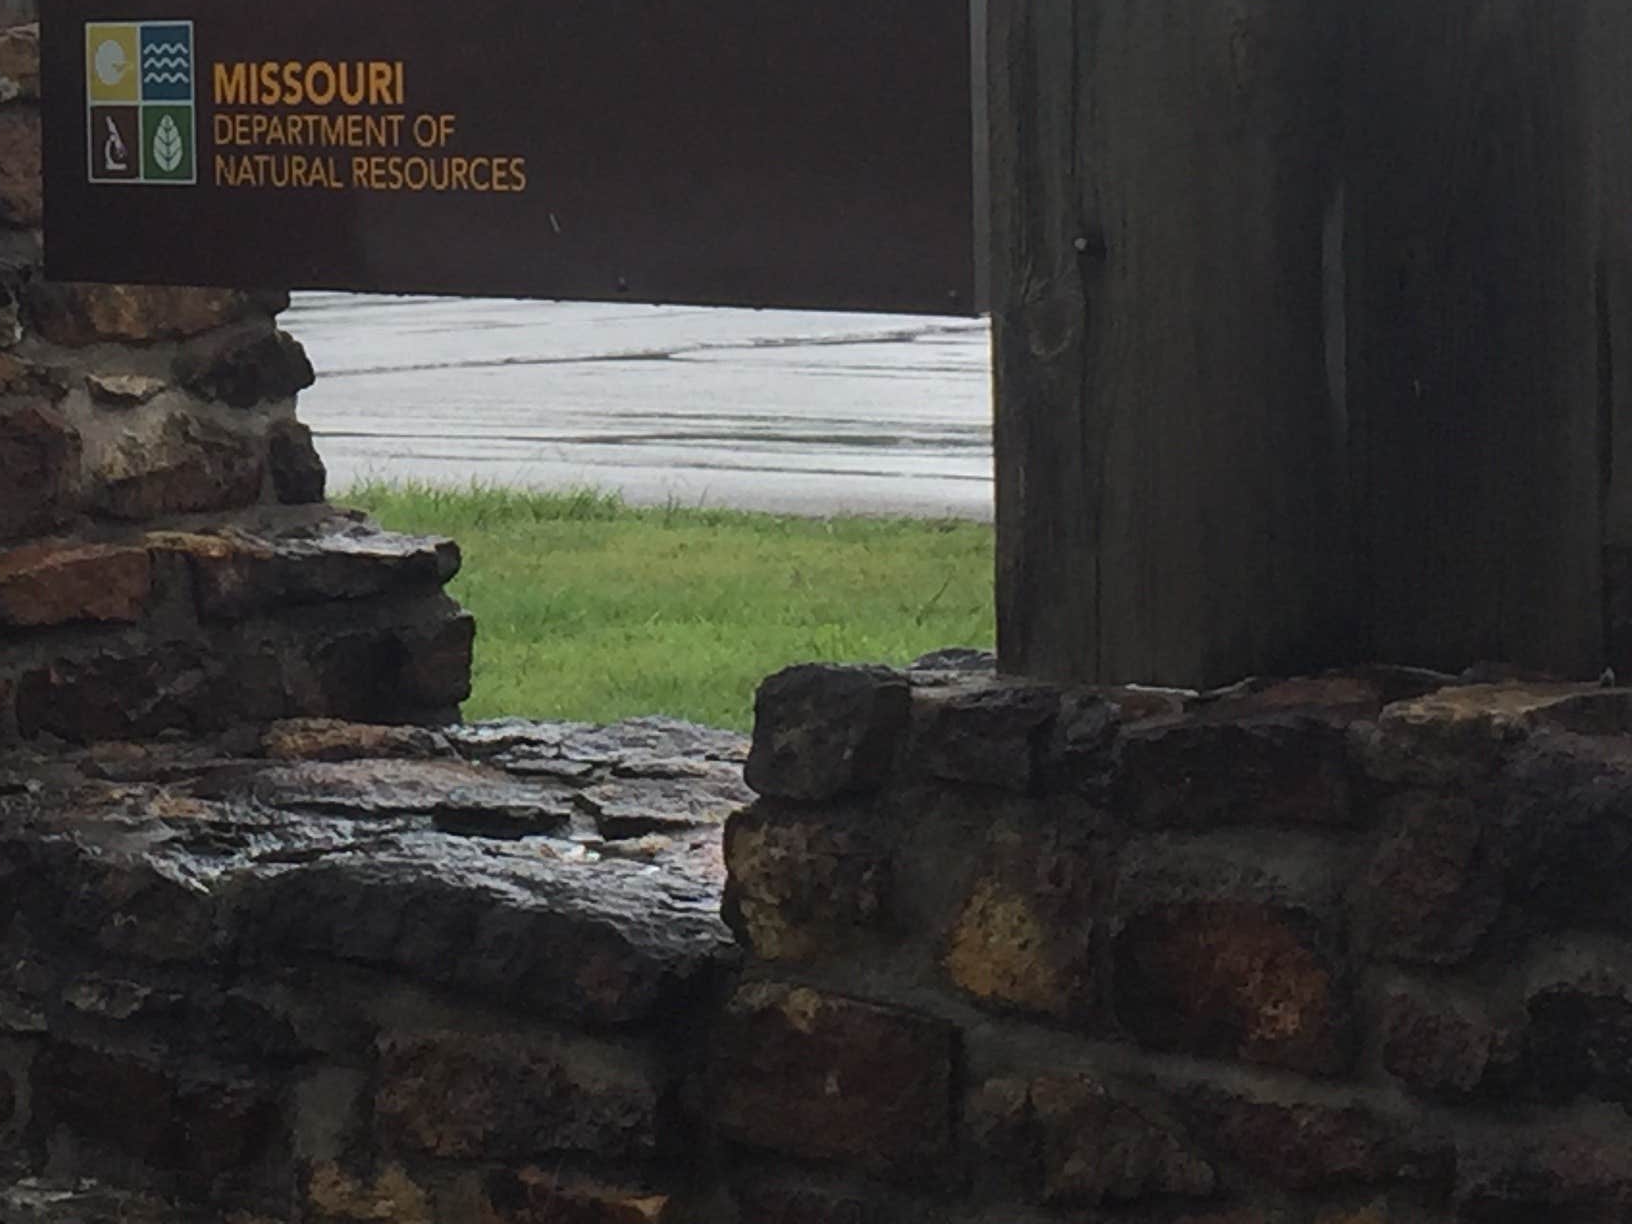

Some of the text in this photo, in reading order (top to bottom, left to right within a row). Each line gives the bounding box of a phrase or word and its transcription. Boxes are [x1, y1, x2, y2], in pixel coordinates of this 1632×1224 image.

[212, 60, 405, 106] MISSOURI
[213, 113, 456, 148] DEPARTMENT OF
[214, 155, 527, 192] NATURAL RESOURCES
